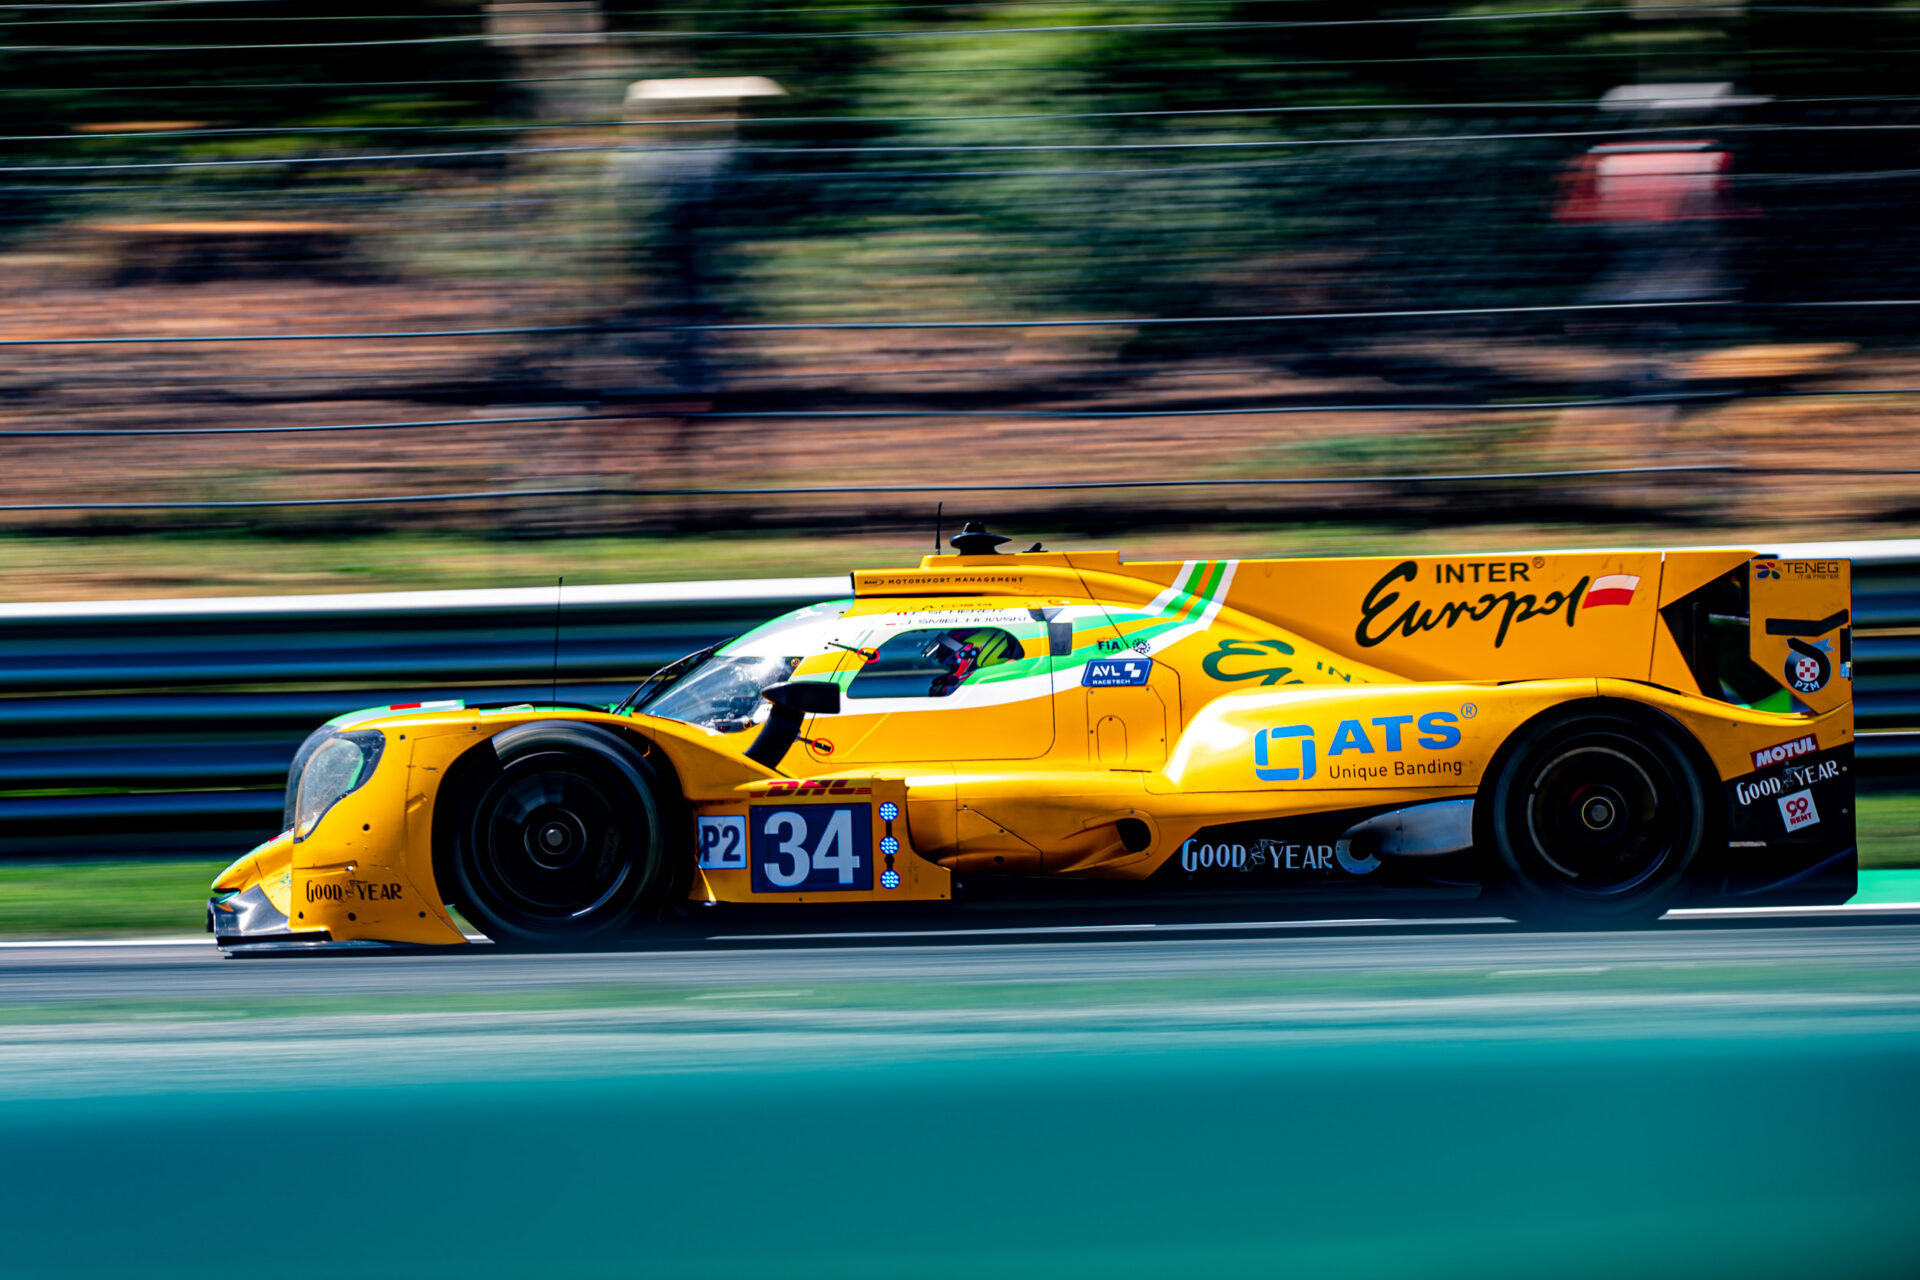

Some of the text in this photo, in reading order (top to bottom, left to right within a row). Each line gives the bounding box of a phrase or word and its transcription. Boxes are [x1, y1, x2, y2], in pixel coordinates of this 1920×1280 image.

[1784, 562, 1839, 573] TENEG
[888, 577, 951, 585] MOTORSPORT
[1355, 560, 1590, 648] Europol
[1097, 640, 1121, 651] FIA
[1092, 665, 1121, 677] AVL
[1794, 680, 1820, 691] PZM
[1756, 736, 1816, 768] MOTUL
[1329, 760, 1463, 781] Unique Banding
[766, 780, 854, 797] DHL
[1736, 760, 1839, 806] GOOD YEAR
[1785, 797, 1809, 817] 99
[1789, 811, 1812, 826] RENT
[764, 809, 860, 887] 34
[1181, 838, 1334, 872] GOOD YEAR
[306, 880, 402, 903] GOOD YEAR
